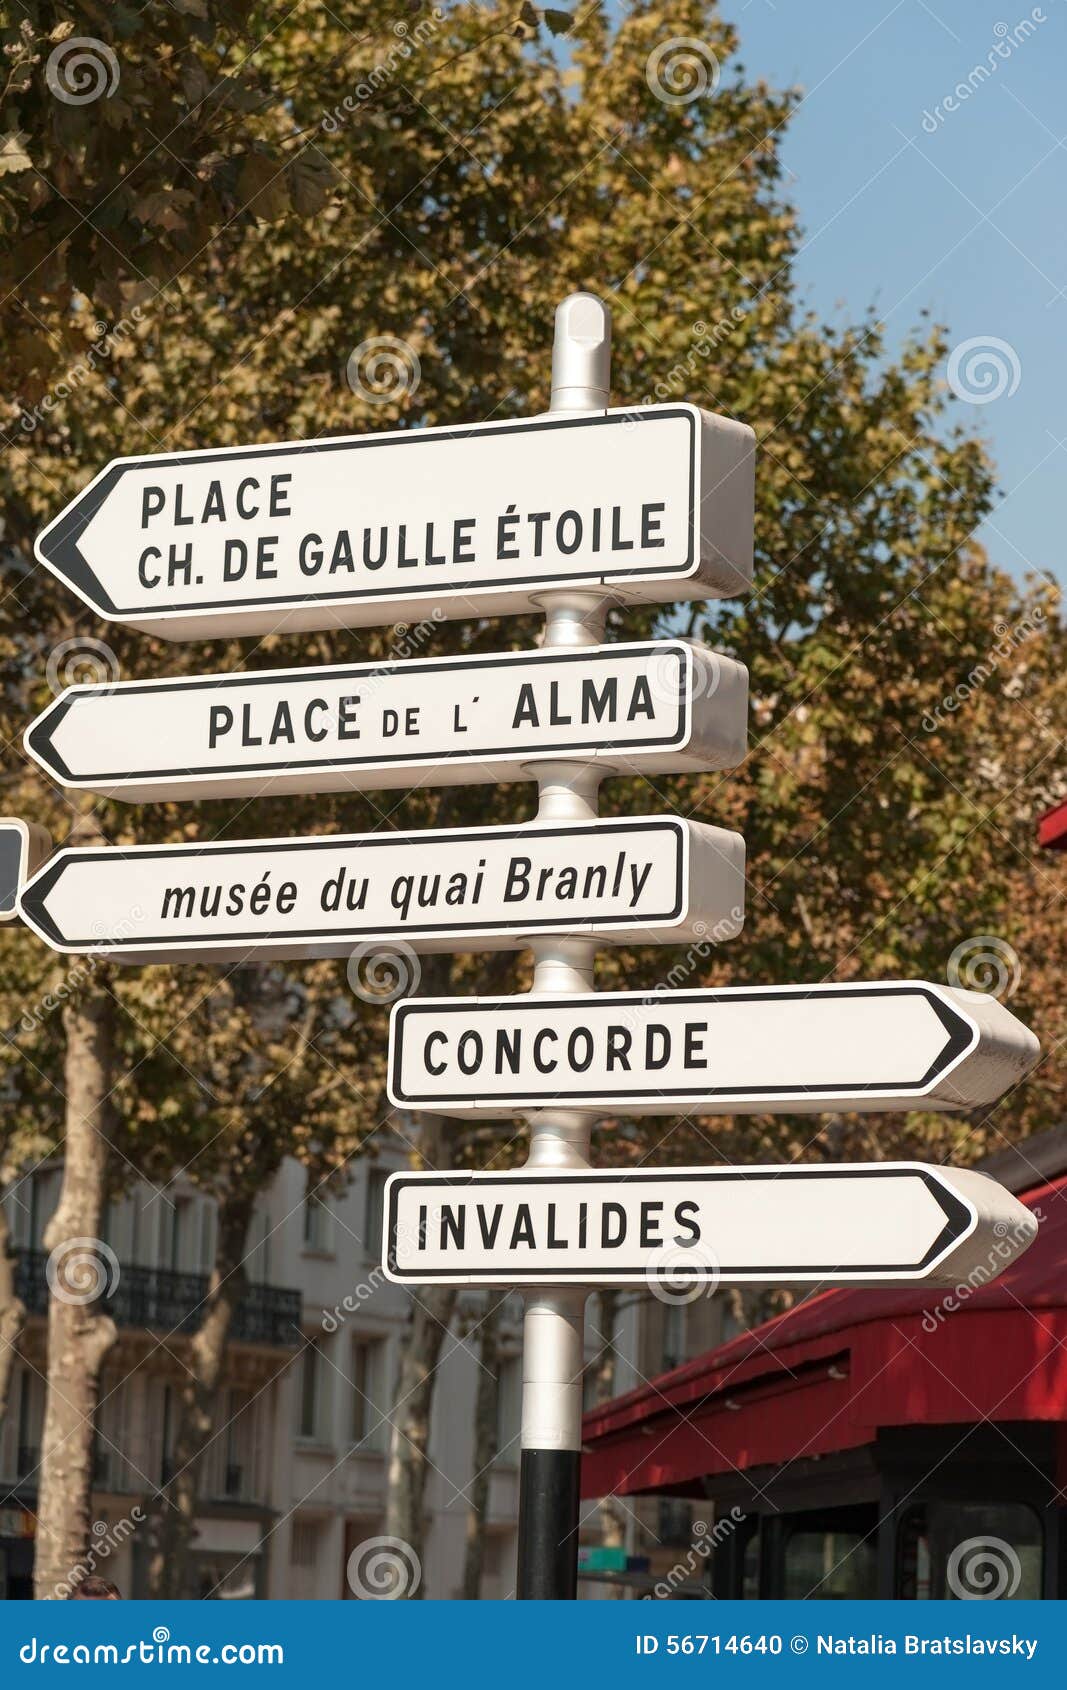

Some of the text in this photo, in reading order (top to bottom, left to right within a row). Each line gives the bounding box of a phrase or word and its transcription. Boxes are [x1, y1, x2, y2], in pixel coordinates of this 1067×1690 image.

[141, 473, 292, 529] PLACE
[138, 502, 665, 589] CH. DE GAULLE ÉTOILE
[208, 696, 361, 749] PLACE
[382, 707, 420, 743] DE
[511, 675, 656, 729] ALMA
[160, 851, 653, 921] musée du quai Branly
[423, 1022, 708, 1076] CONCORDE
[418, 1200, 701, 1251] INVALIDES
